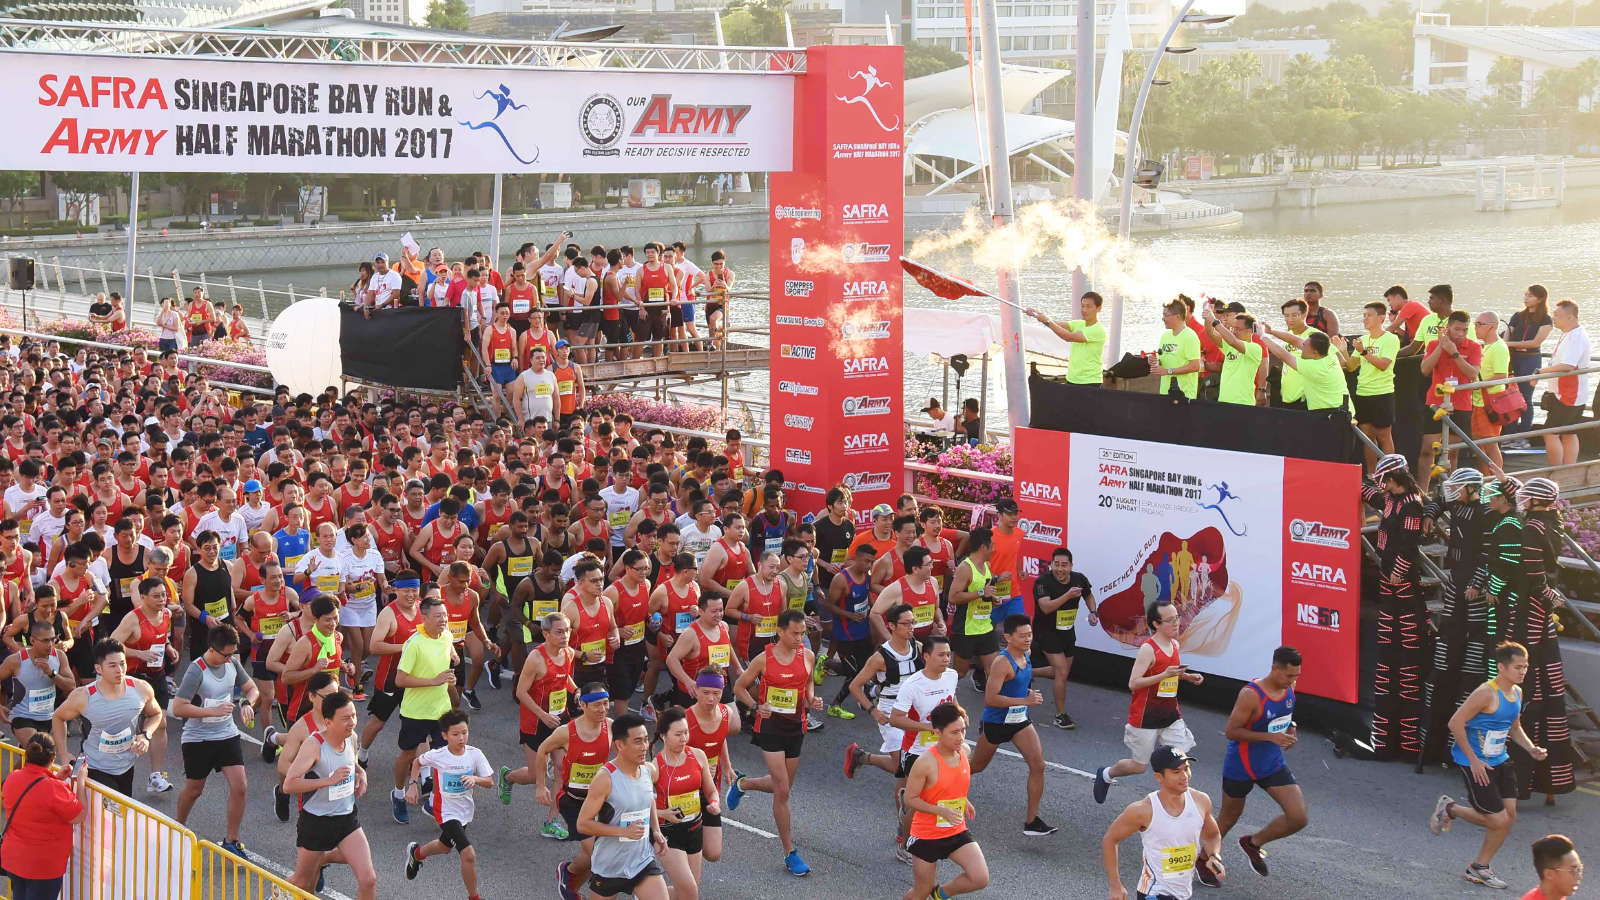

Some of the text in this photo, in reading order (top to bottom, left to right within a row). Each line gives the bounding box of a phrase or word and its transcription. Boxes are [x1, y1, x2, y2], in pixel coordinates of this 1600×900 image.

[38, 74, 453, 117] SAFRA SINGAPORE BAY RUN &
[626, 93, 752, 137] OUR ARMY
[40, 118, 453, 159] ARMY HALF MARATHON 2017
[624, 147, 653, 157] READY
[656, 147, 697, 157] DECISIVE
[699, 147, 751, 157] RESPECTED
[843, 204, 888, 218] SAFRA
[843, 281, 888, 295] SAFRA
[791, 346, 815, 359] ACTIVE
[843, 357, 889, 372] SAFRA
[858, 397, 889, 409] ARMY
[844, 432, 889, 449] SAFRA
[1113, 451, 1134, 460] EDITION
[858, 473, 889, 485] ARMY
[1099, 463, 1128, 476] SAFRA
[1129, 467, 1165, 481] SINGAPORE
[1167, 472, 1181, 483] BAY
[1183, 475, 1197, 486] RUN
[1020, 481, 1061, 501] SAFRA
[1099, 475, 1202, 500] ARMY HALF MARATHON 2017
[1116, 497, 1137, 505] AUGUST
[1116, 503, 1137, 512] SUNDAY
[1031, 522, 1061, 537] ARMY
[1308, 523, 1349, 540] ARMY
[1099, 565, 1134, 593] TOGETHER
[1291, 561, 1347, 584] SAFRA
[1168, 854, 1191, 865] 99022
